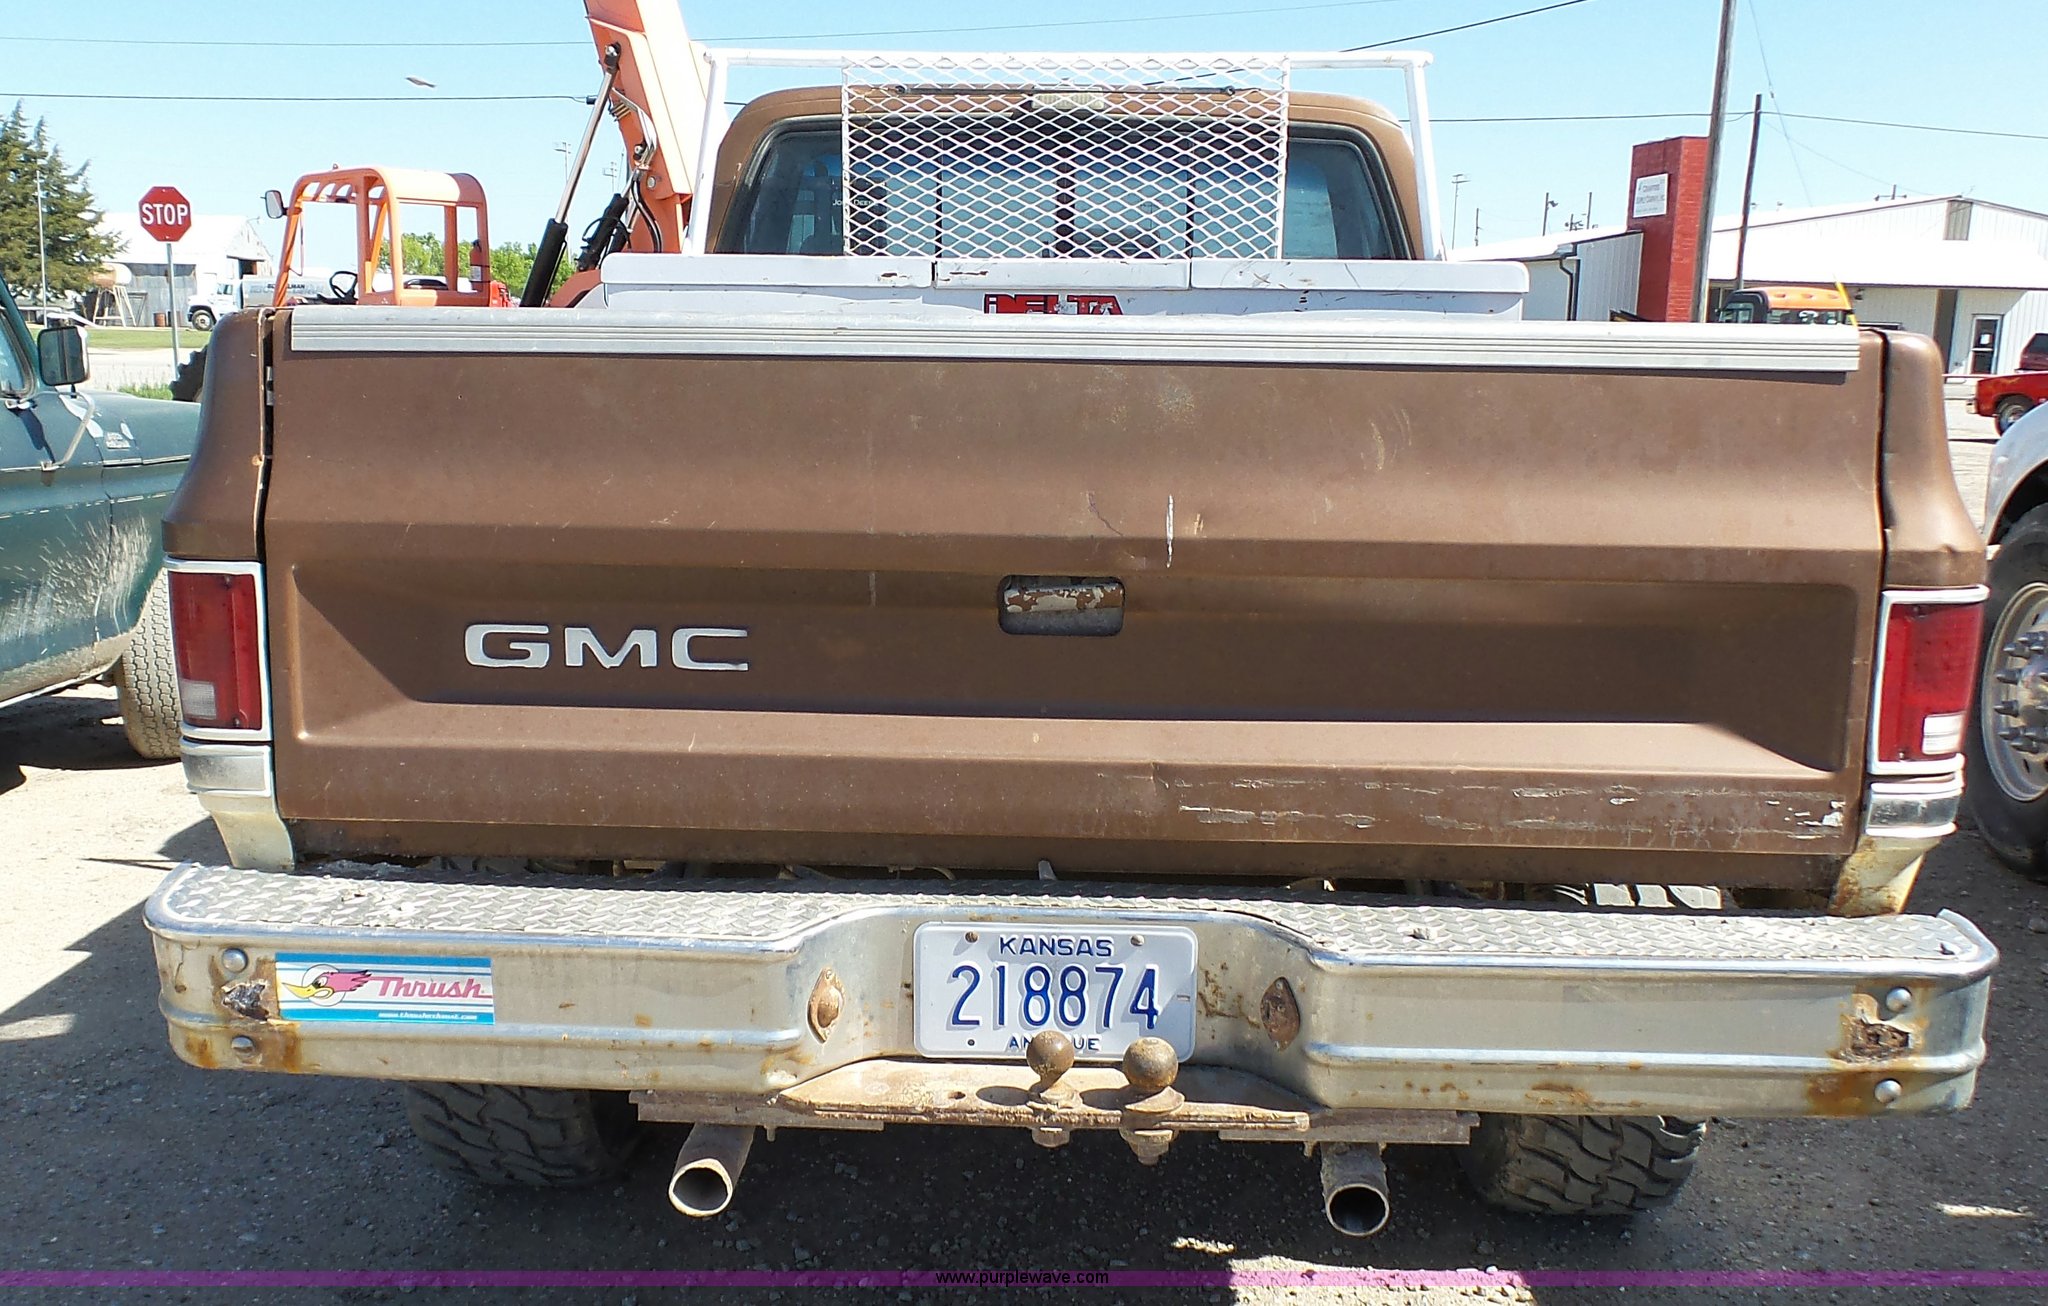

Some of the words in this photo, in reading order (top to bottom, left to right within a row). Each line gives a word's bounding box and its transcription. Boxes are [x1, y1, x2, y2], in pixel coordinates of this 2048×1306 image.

[142, 203, 188, 226] STOP
[465, 624, 749, 671] GMC
[1000, 937, 1113, 957] KANSAS
[368, 976, 494, 999] Thrush
[951, 964, 1159, 1030] 218874
[1009, 1036, 1099, 1051] ANUE
